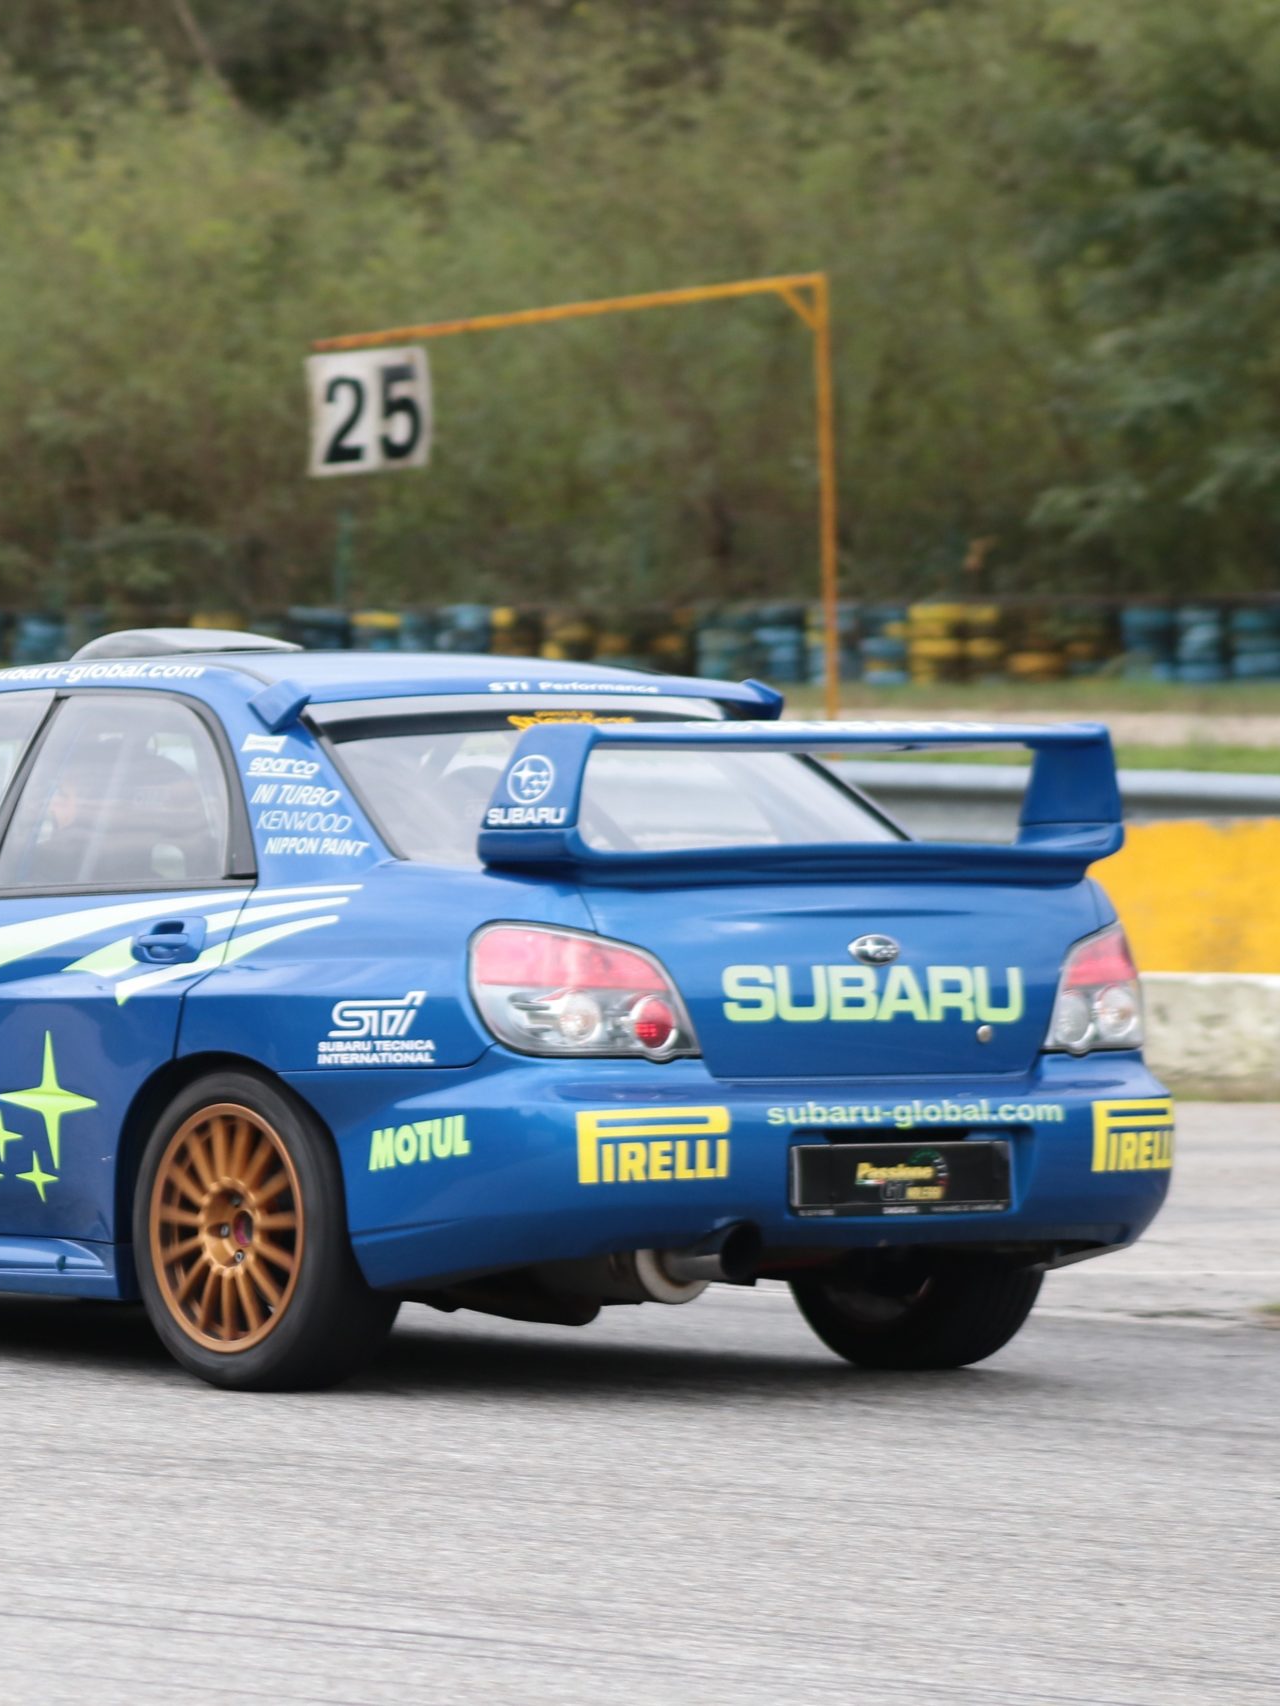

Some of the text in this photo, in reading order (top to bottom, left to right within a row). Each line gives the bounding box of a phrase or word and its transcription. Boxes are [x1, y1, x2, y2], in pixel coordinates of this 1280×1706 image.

[324, 365, 421, 464] 25
[538, 682, 659, 693] Performance
[249, 757, 320, 775] sparco
[250, 784, 342, 807] INI TURBO
[256, 810, 353, 833] KENWOOD
[487, 808, 567, 825] SUBARU
[264, 837, 370, 857] NIPPON PAINT
[722, 965, 1024, 1022] SUBARU
[318, 1040, 435, 1052] SUBARU TECNICA
[317, 1053, 435, 1065] INTERNATIONAL
[767, 1099, 1064, 1129] subaru-global.com
[368, 1114, 471, 1171] MOTUL
[576, 1105, 731, 1184] PIRELLI
